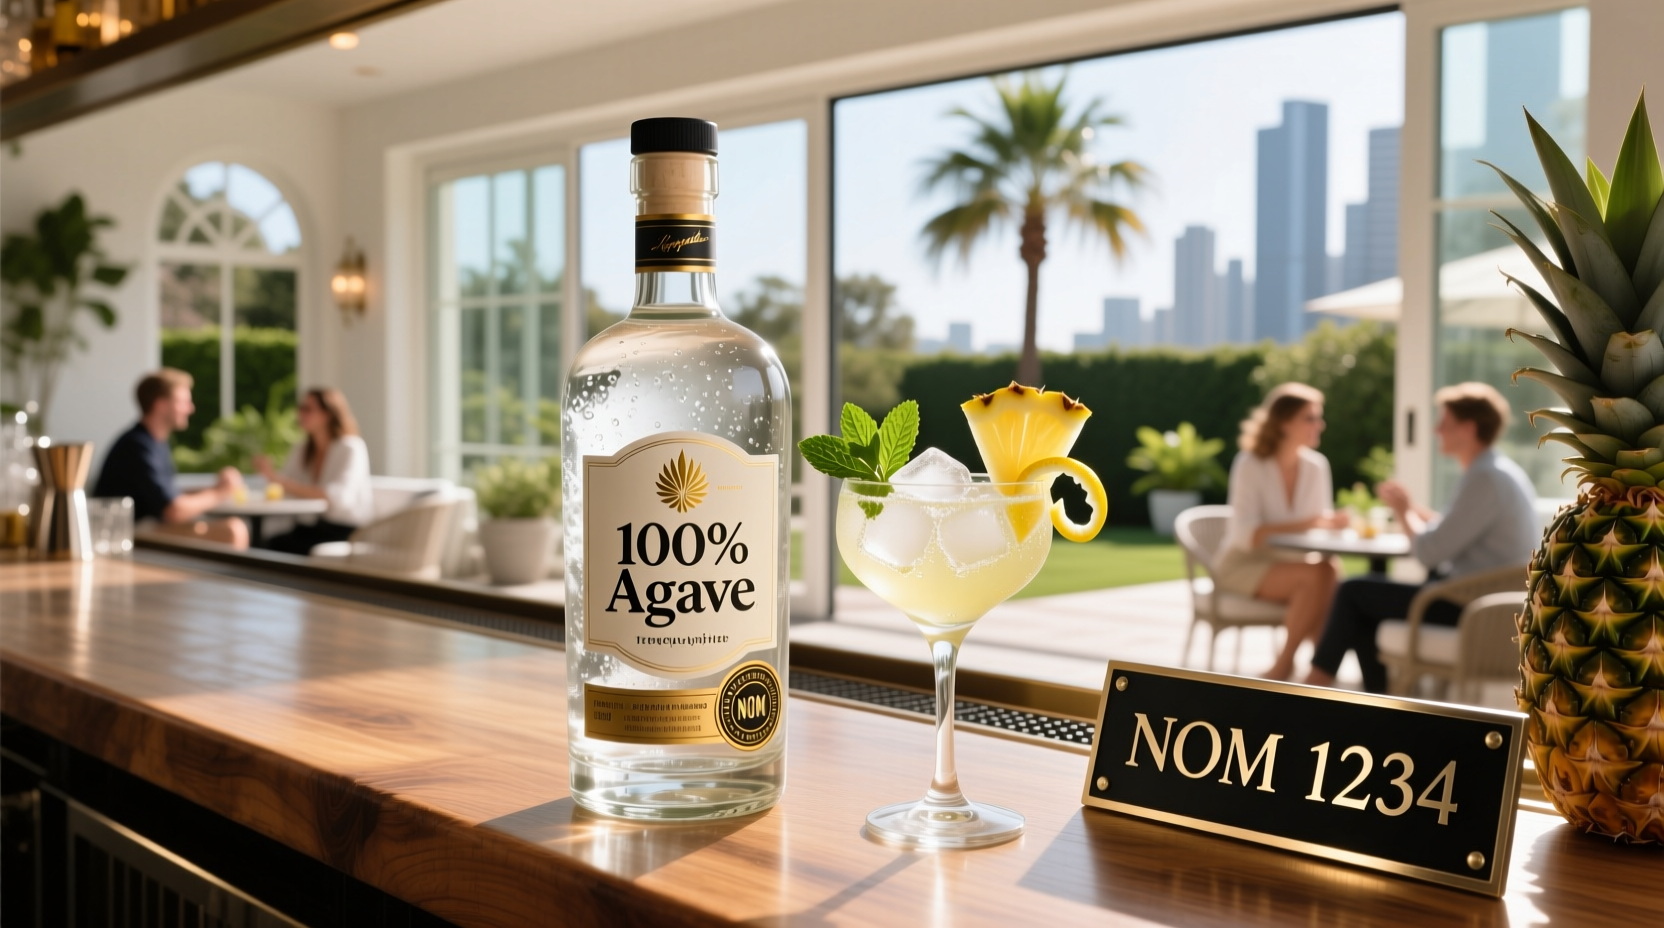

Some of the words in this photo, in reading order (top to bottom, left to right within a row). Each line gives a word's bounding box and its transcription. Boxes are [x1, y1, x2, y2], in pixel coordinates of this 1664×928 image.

[617, 522, 749, 566] 100%
[605, 568, 755, 628] Agave
[737, 694, 766, 720] NOM
[1125, 713, 1284, 793] NOM
[1305, 741, 1458, 826] 1234
